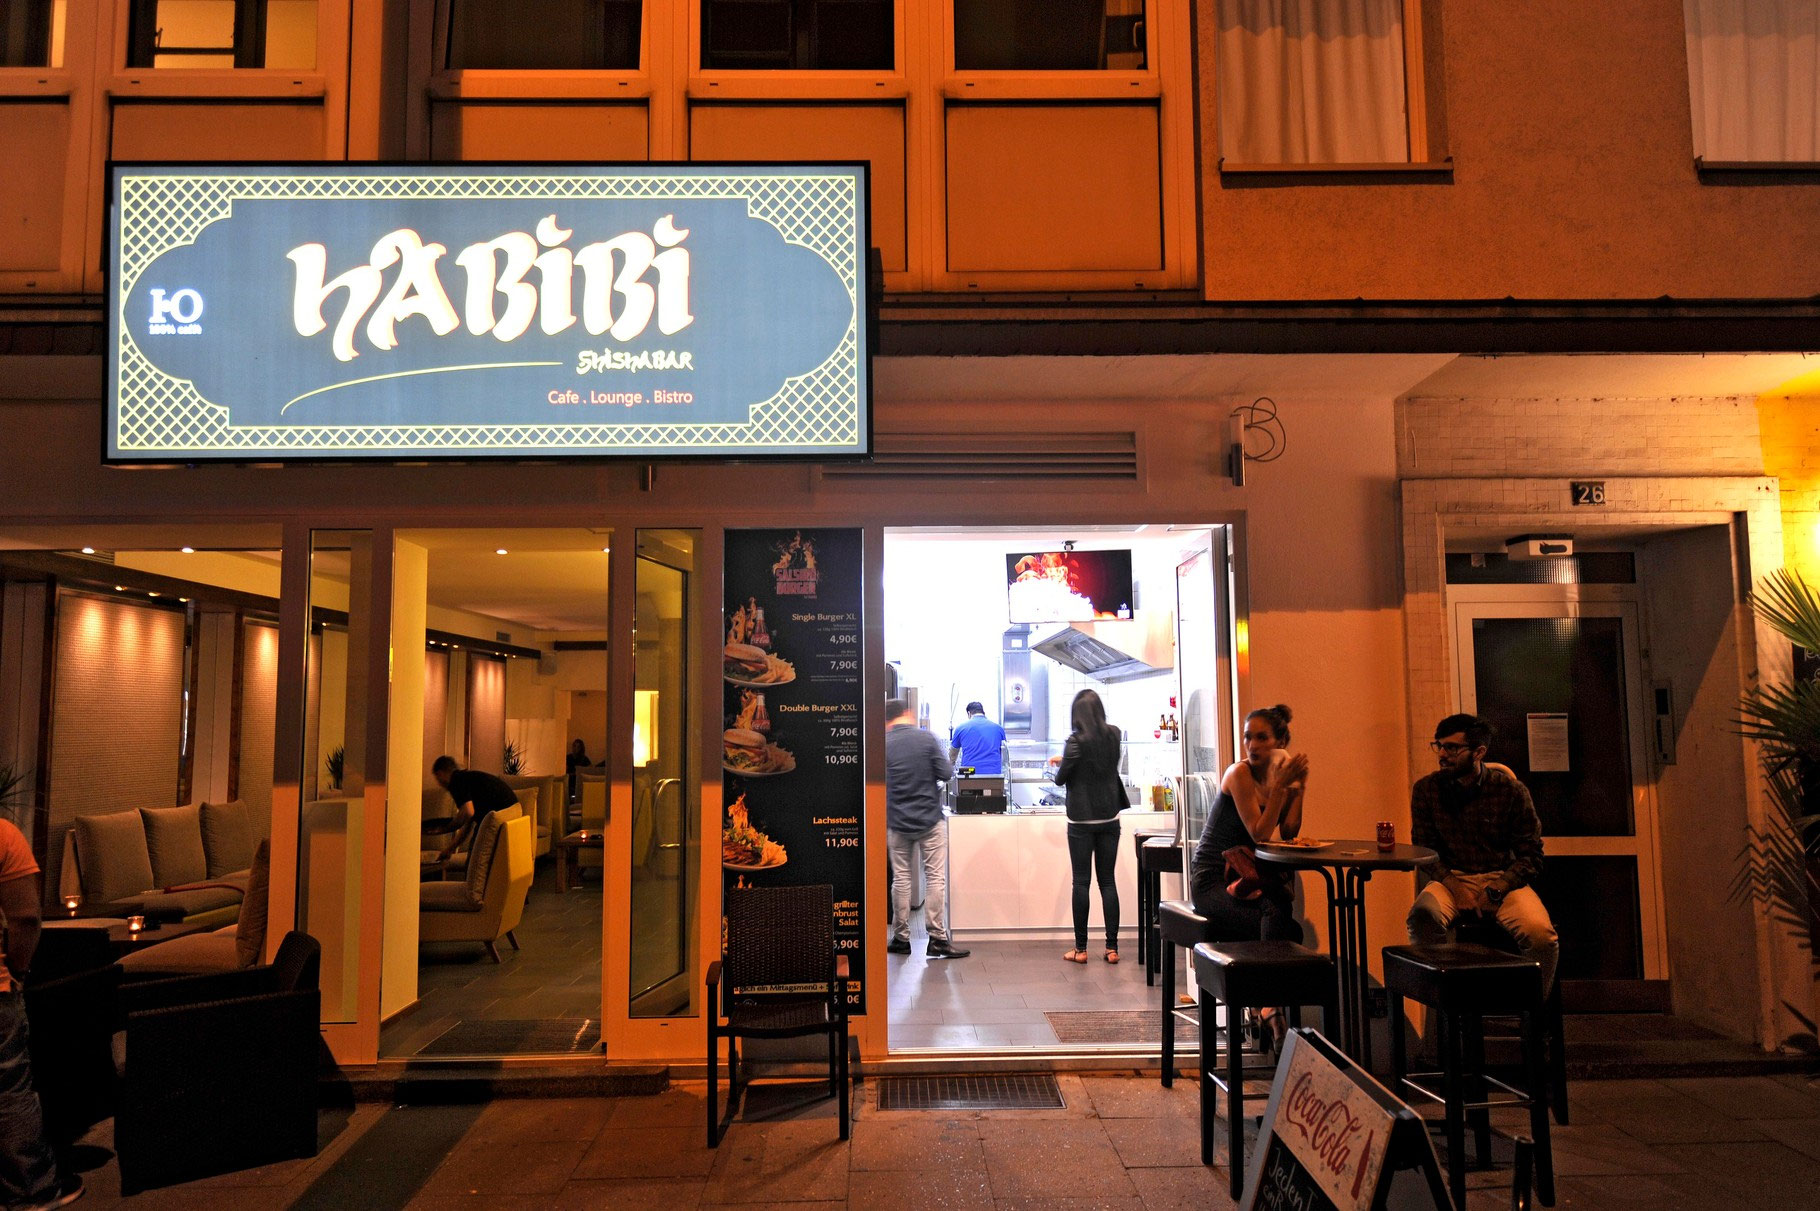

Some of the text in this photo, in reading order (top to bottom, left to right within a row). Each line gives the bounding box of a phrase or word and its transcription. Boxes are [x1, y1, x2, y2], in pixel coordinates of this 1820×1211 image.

[548, 390, 579, 404] Cafe
[591, 390, 642, 407] Lounge
[654, 389, 693, 404] Bistro
[1579, 485, 1604, 503] 26
[792, 613, 815, 622] Single
[817, 613, 844, 622] Burger
[830, 634, 857, 644] 4,90€
[830, 661, 858, 670] 7,90€
[780, 704, 810, 712] Double
[812, 704, 839, 713] Burger
[830, 728, 858, 737] 7,90€
[825, 755, 858, 765] 10,90€
[813, 816, 858, 824] Lachssteak
[825, 838, 858, 848] 11,90€
[839, 918, 859, 926] Salat
